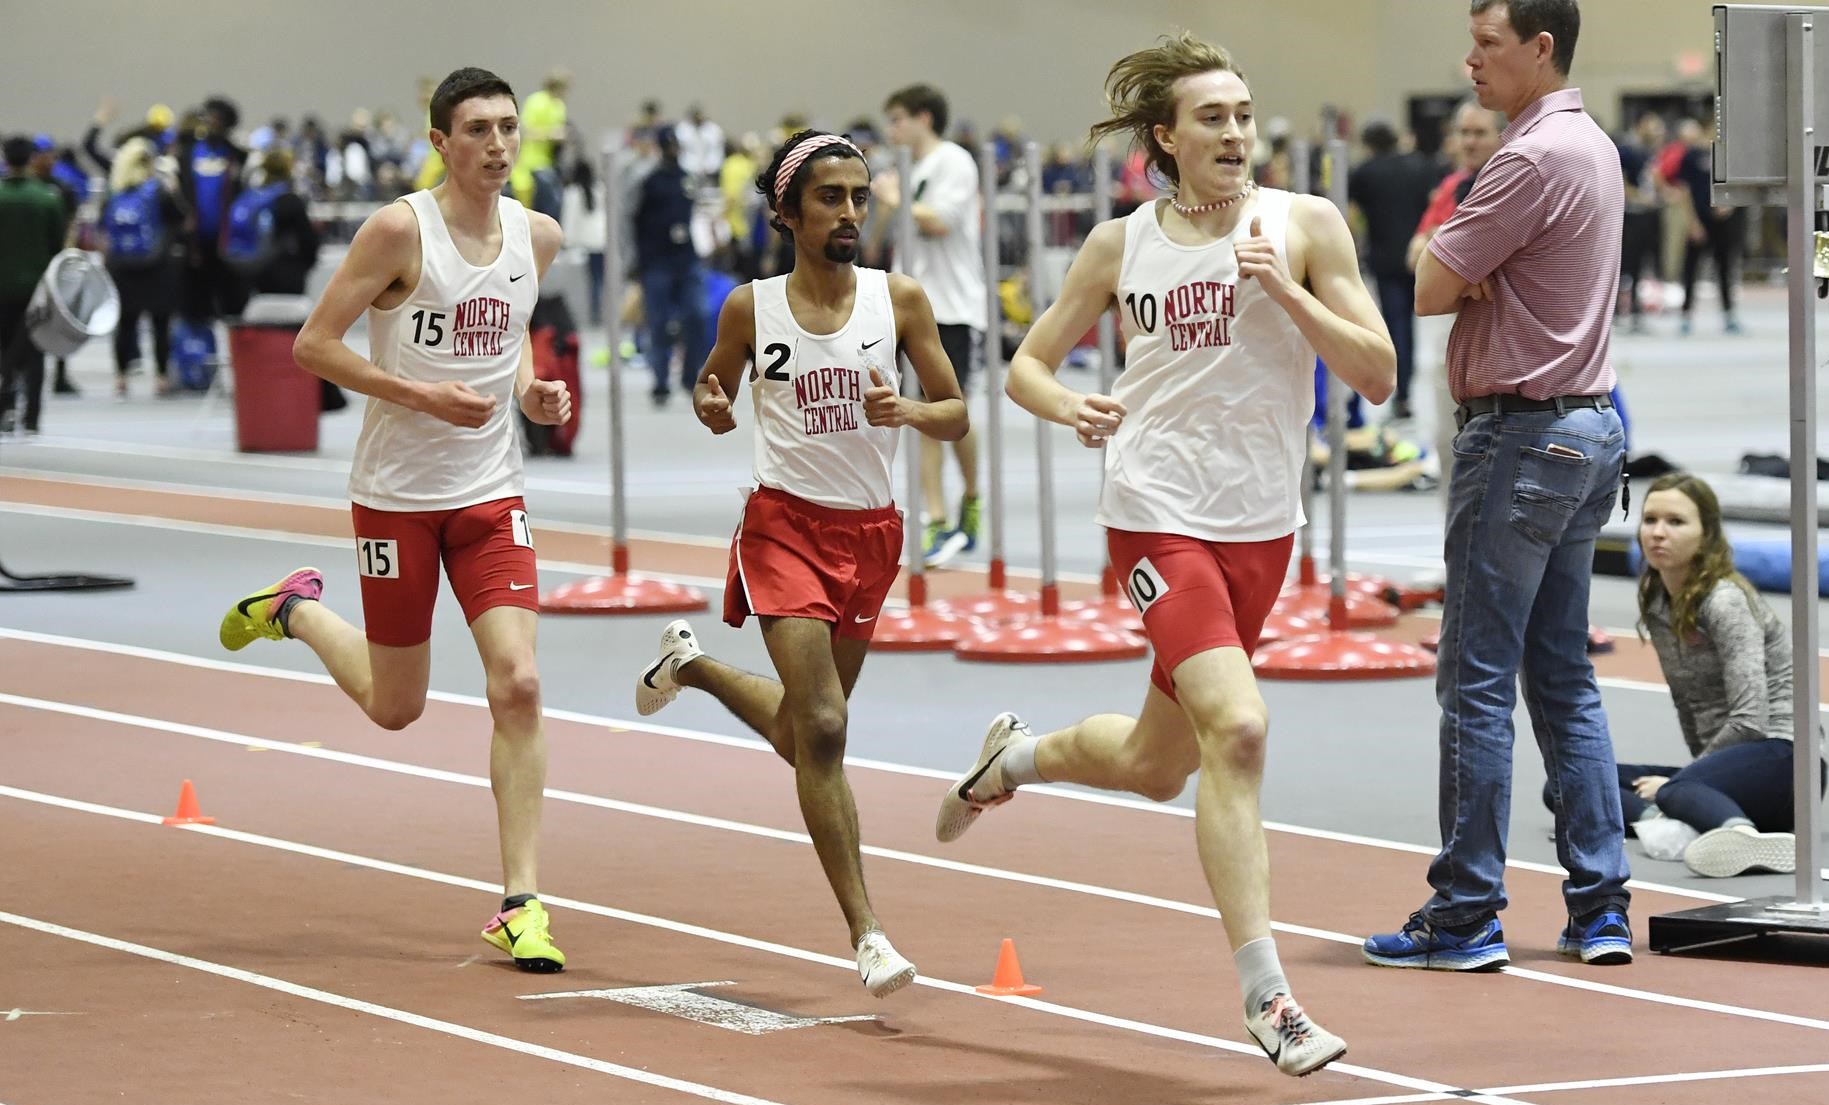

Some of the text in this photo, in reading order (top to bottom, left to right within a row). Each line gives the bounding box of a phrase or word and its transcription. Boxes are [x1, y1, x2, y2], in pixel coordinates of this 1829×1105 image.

[452, 297, 511, 332] NORTH
[1125, 293, 1157, 333] 10
[1164, 281, 1236, 327] NORTH
[411, 309, 446, 347] 15
[453, 331, 503, 357] CENTRAL
[1170, 317, 1231, 351] CENTRAL
[763, 342, 791, 382] 2
[794, 367, 862, 410] NORTH
[804, 403, 859, 436] CENTRAL
[362, 541, 391, 576] 15
